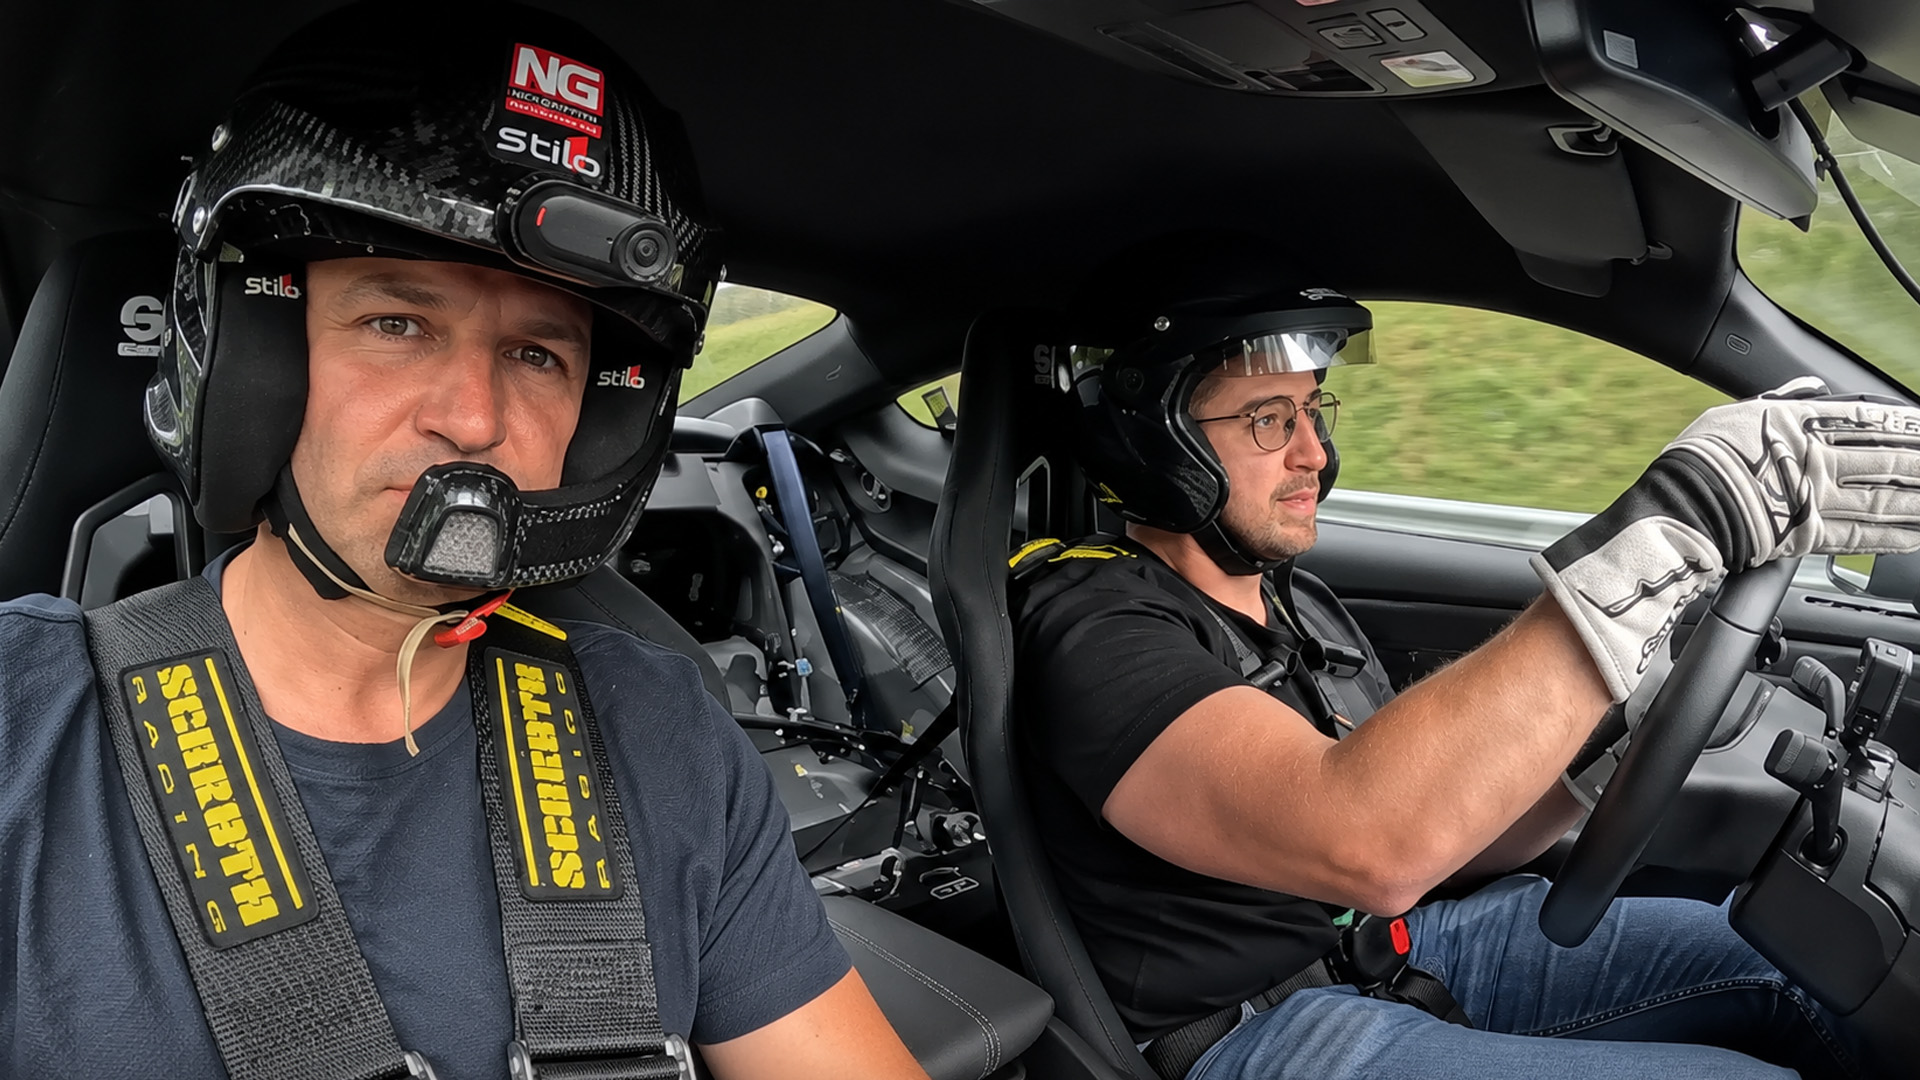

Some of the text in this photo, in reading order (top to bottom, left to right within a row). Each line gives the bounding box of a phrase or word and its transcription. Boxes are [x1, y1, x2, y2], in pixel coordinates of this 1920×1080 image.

[514, 46, 601, 111] NG
[496, 126, 601, 178] Stilo
[244, 274, 300, 299] Stilo
[597, 365, 646, 390] Stilo
